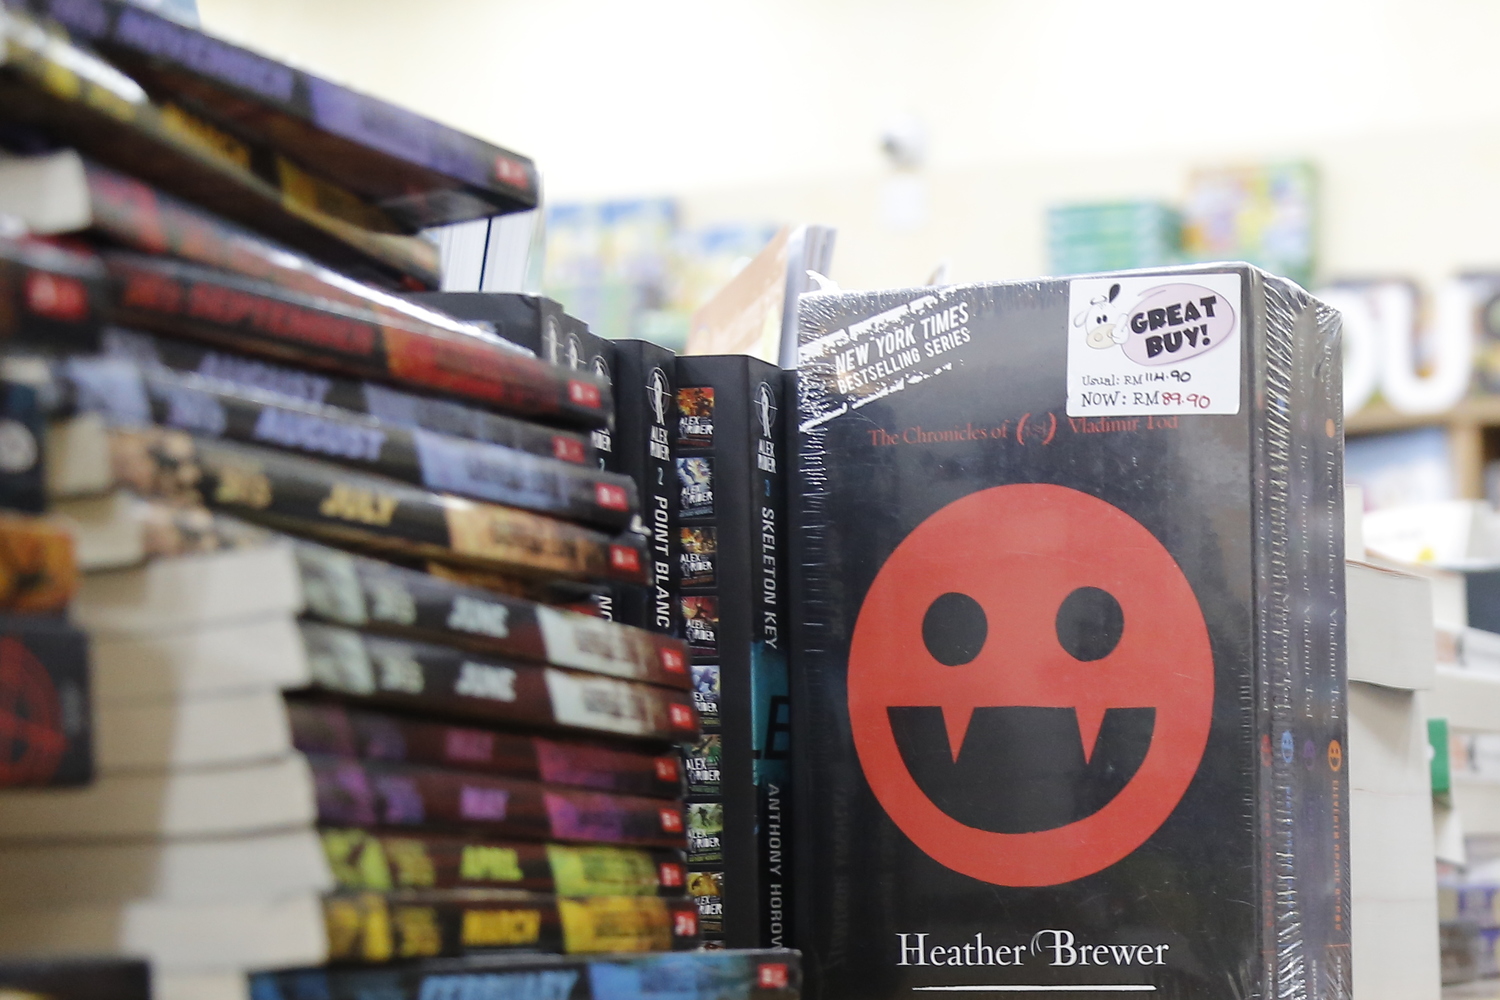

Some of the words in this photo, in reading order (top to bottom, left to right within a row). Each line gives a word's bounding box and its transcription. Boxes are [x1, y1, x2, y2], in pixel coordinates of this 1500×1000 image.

[834, 342, 869, 374] NEW
[875, 323, 917, 358] YORK
[920, 302, 969, 340] TIMES
[1130, 295, 1217, 334] GREAT
[837, 347, 921, 395] BESTSELLING
[924, 327, 971, 358] SERIES
[1145, 324, 1211, 358] BUY!
[1082, 374, 1120, 386] Usual:
[867, 428, 899, 447] The
[902, 422, 987, 445] Chronicles
[991, 418, 1010, 439] of
[654, 495, 669, 556] POINT
[761, 506, 777, 605] SKELETON
[655, 561, 670, 628] BLANC
[763, 611, 778, 649] KEY
[767, 782, 782, 876] ANTHONY
[895, 932, 1027, 966] Heather
[1030, 929, 1170, 966] Brewer
